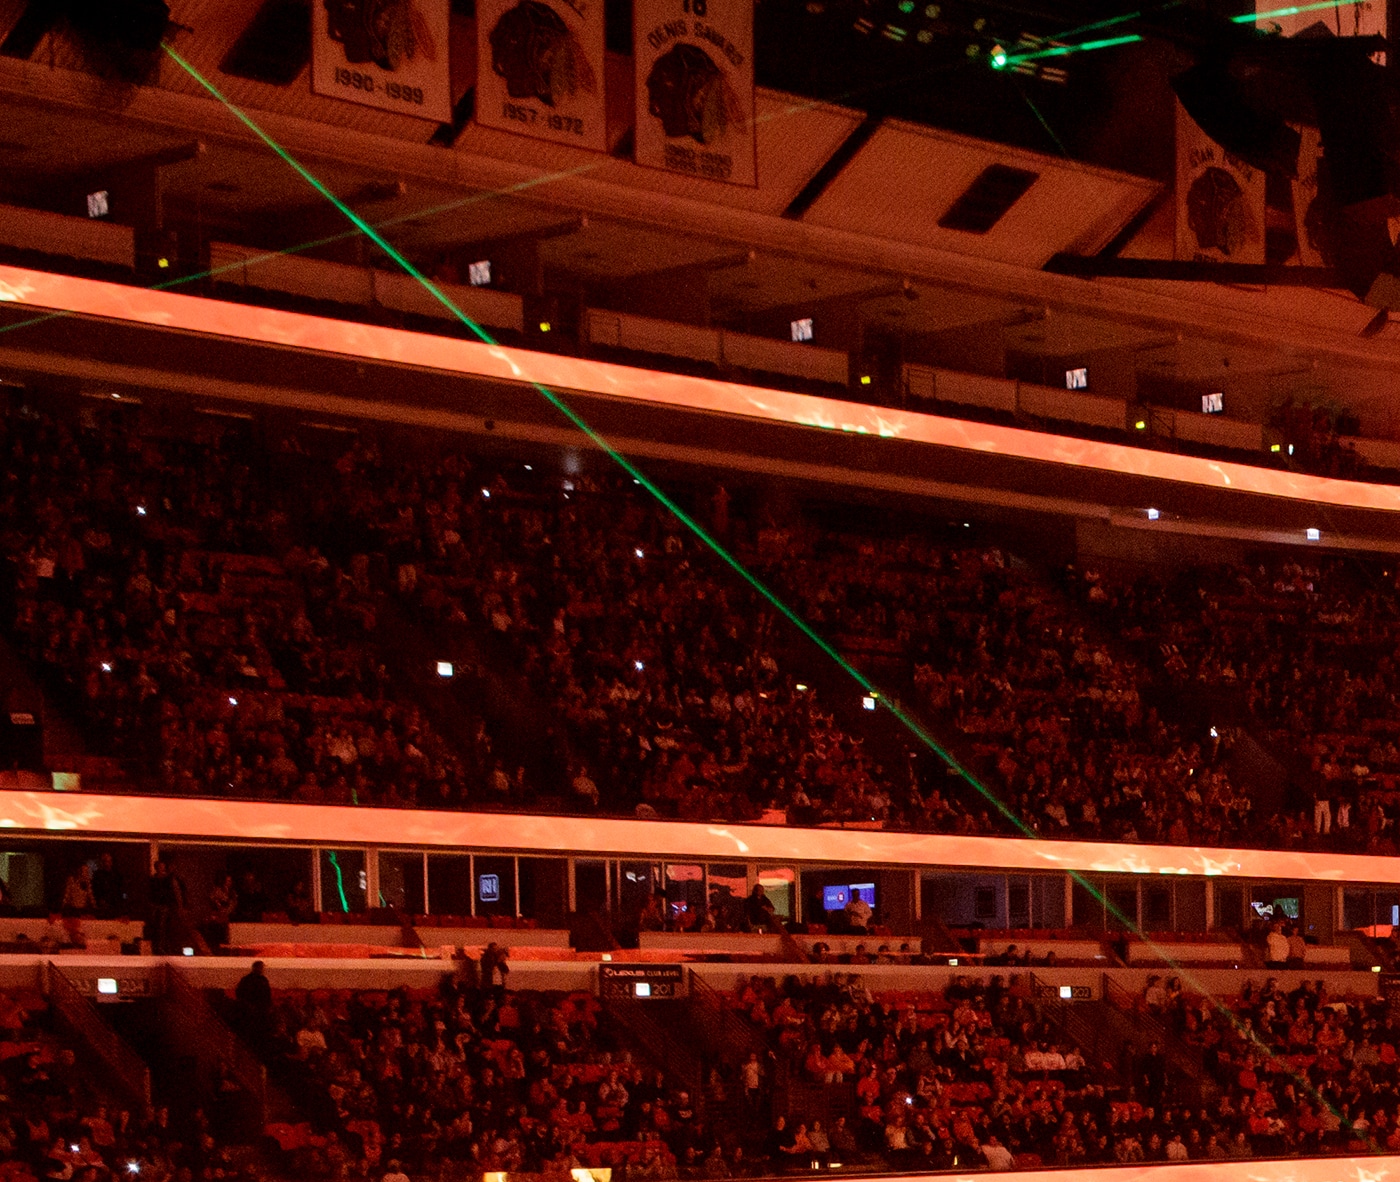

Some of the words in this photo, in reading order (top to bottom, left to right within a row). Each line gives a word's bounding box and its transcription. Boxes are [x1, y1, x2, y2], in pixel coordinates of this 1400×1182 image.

[647, 20, 687, 49] DENIS
[613, 969, 645, 977] LEXUS
[652, 984, 672, 996] 201
